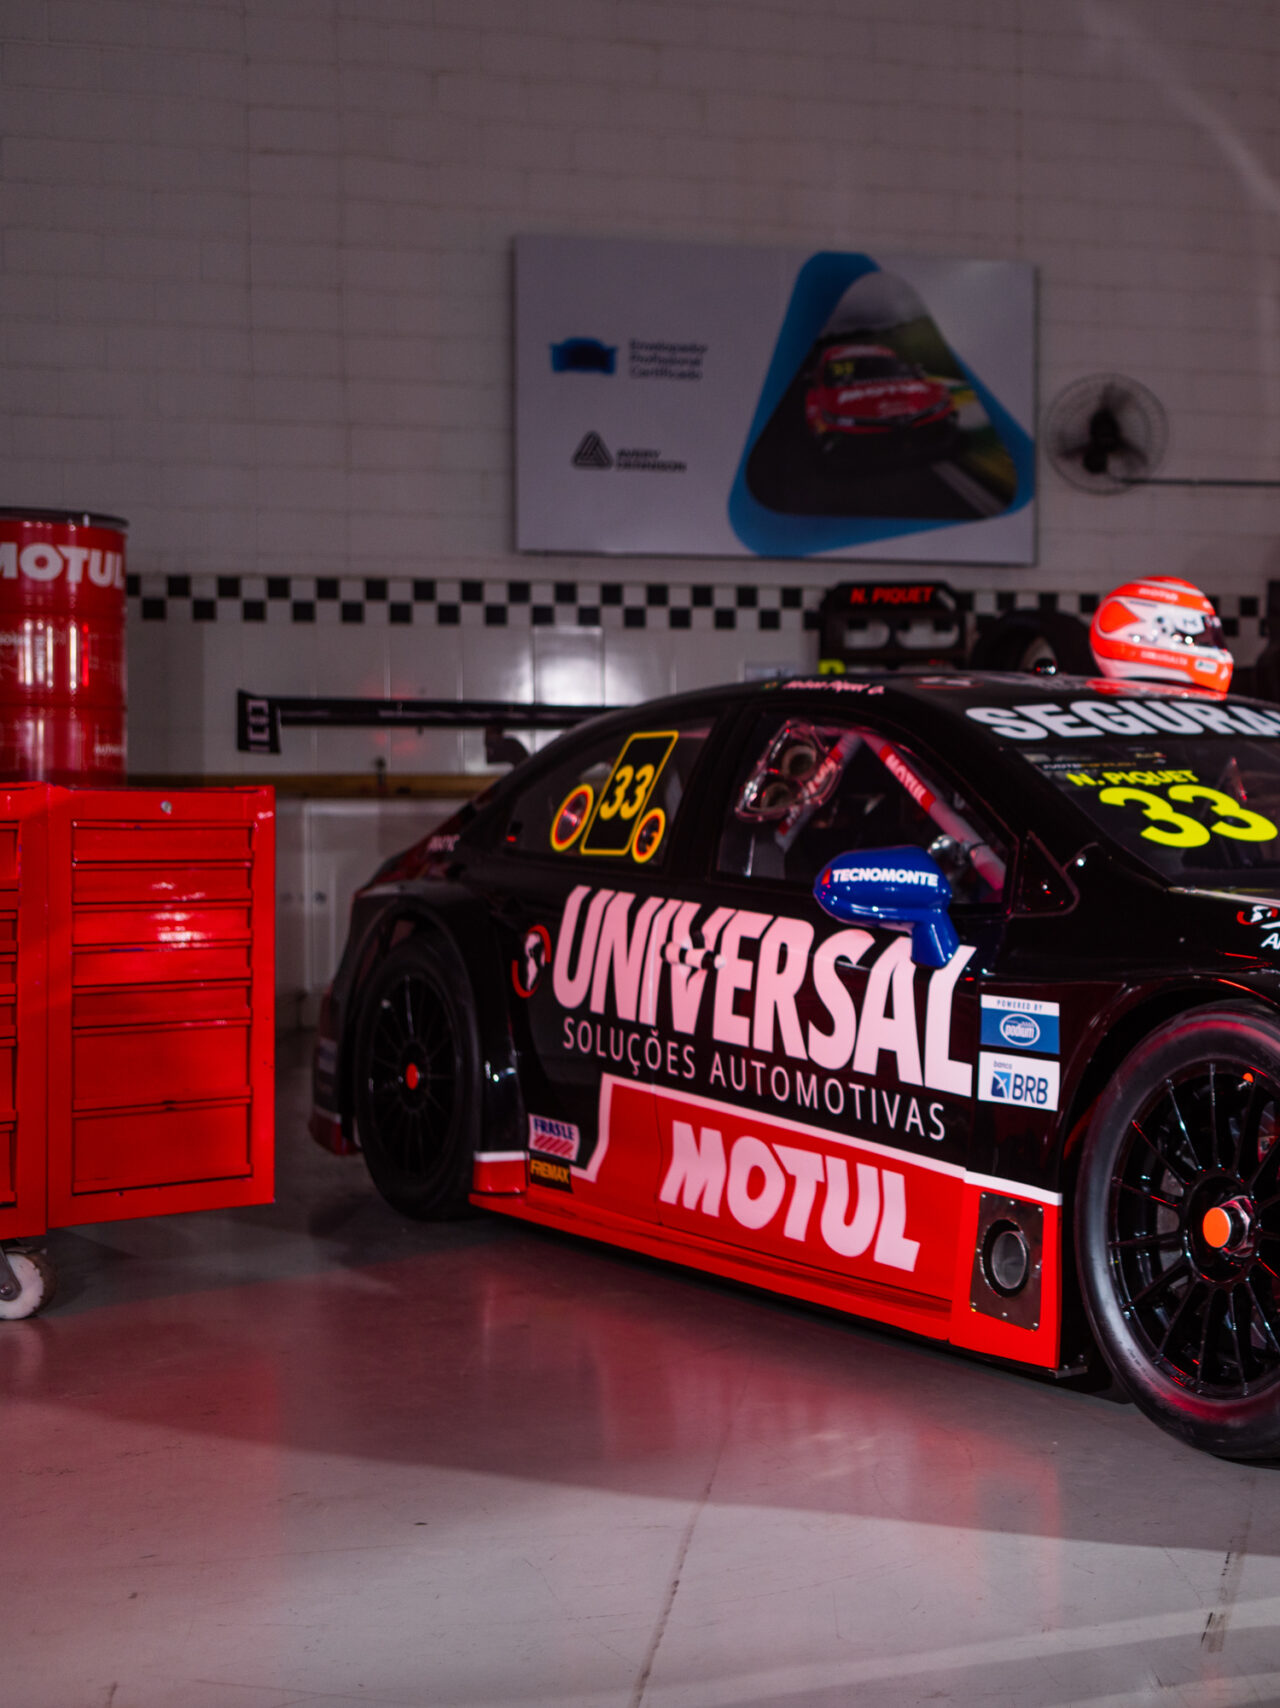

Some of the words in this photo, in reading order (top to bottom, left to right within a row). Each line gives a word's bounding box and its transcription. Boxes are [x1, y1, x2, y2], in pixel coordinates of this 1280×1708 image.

[871, 585, 935, 605] PIQUET
[600, 764, 655, 820] 33
[1101, 769, 1199, 786] PIQUET
[1099, 784, 1279, 848] 33
[832, 868, 939, 887] TECNOMONTE
[553, 885, 977, 1098] UNIVERSAL
[562, 1016, 696, 1079] SOLUÇÕES
[709, 1052, 947, 1142] AUTOMOTIVAS
[1012, 1073, 1049, 1105] BRB
[659, 1120, 922, 1273] MOTUL
